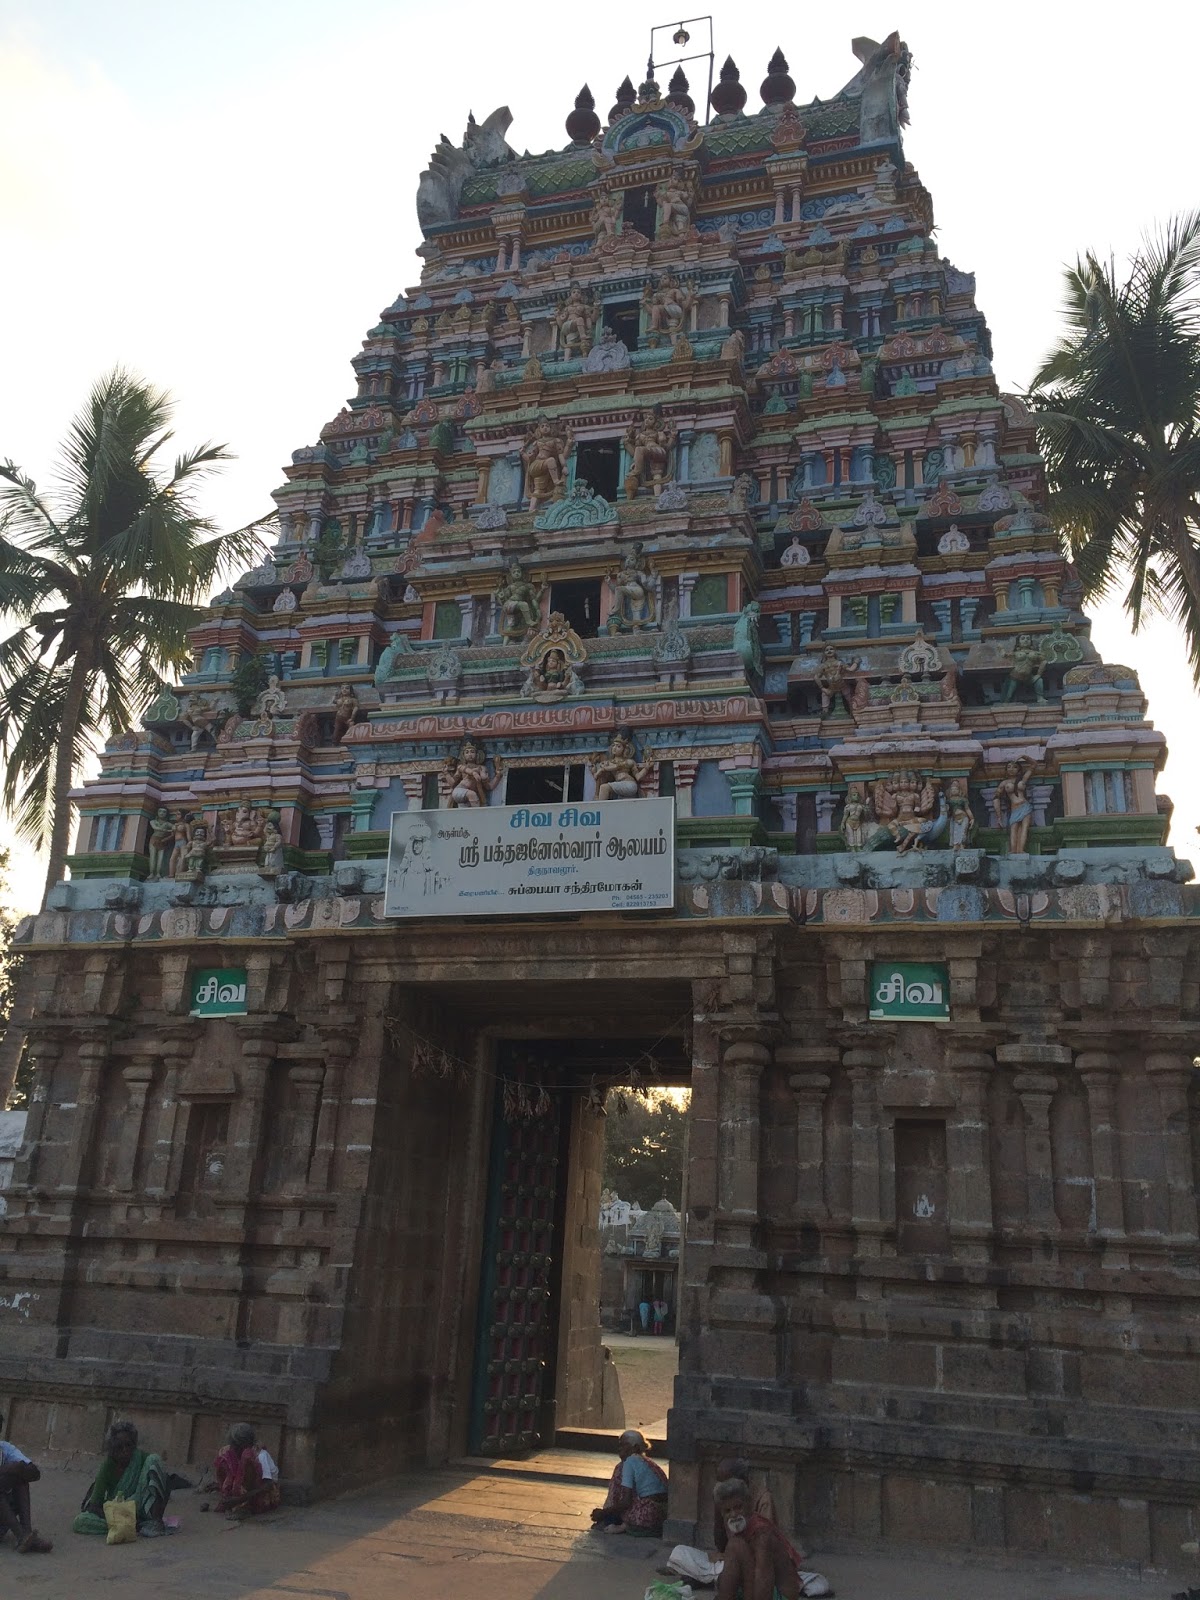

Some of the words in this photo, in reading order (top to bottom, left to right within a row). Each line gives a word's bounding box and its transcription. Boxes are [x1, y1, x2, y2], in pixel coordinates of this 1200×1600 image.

[510, 808, 552, 828] சிவ
[558, 808, 601, 827] சிவ
[483, 831, 602, 866] பக்தஜனேஸ்வரர்
[606, 828, 667, 861] ஆலயம்
[563, 879, 643, 895] சந்திரமோகன்
[196, 976, 247, 1004] சிவ
[876, 972, 943, 1004] சிவ
